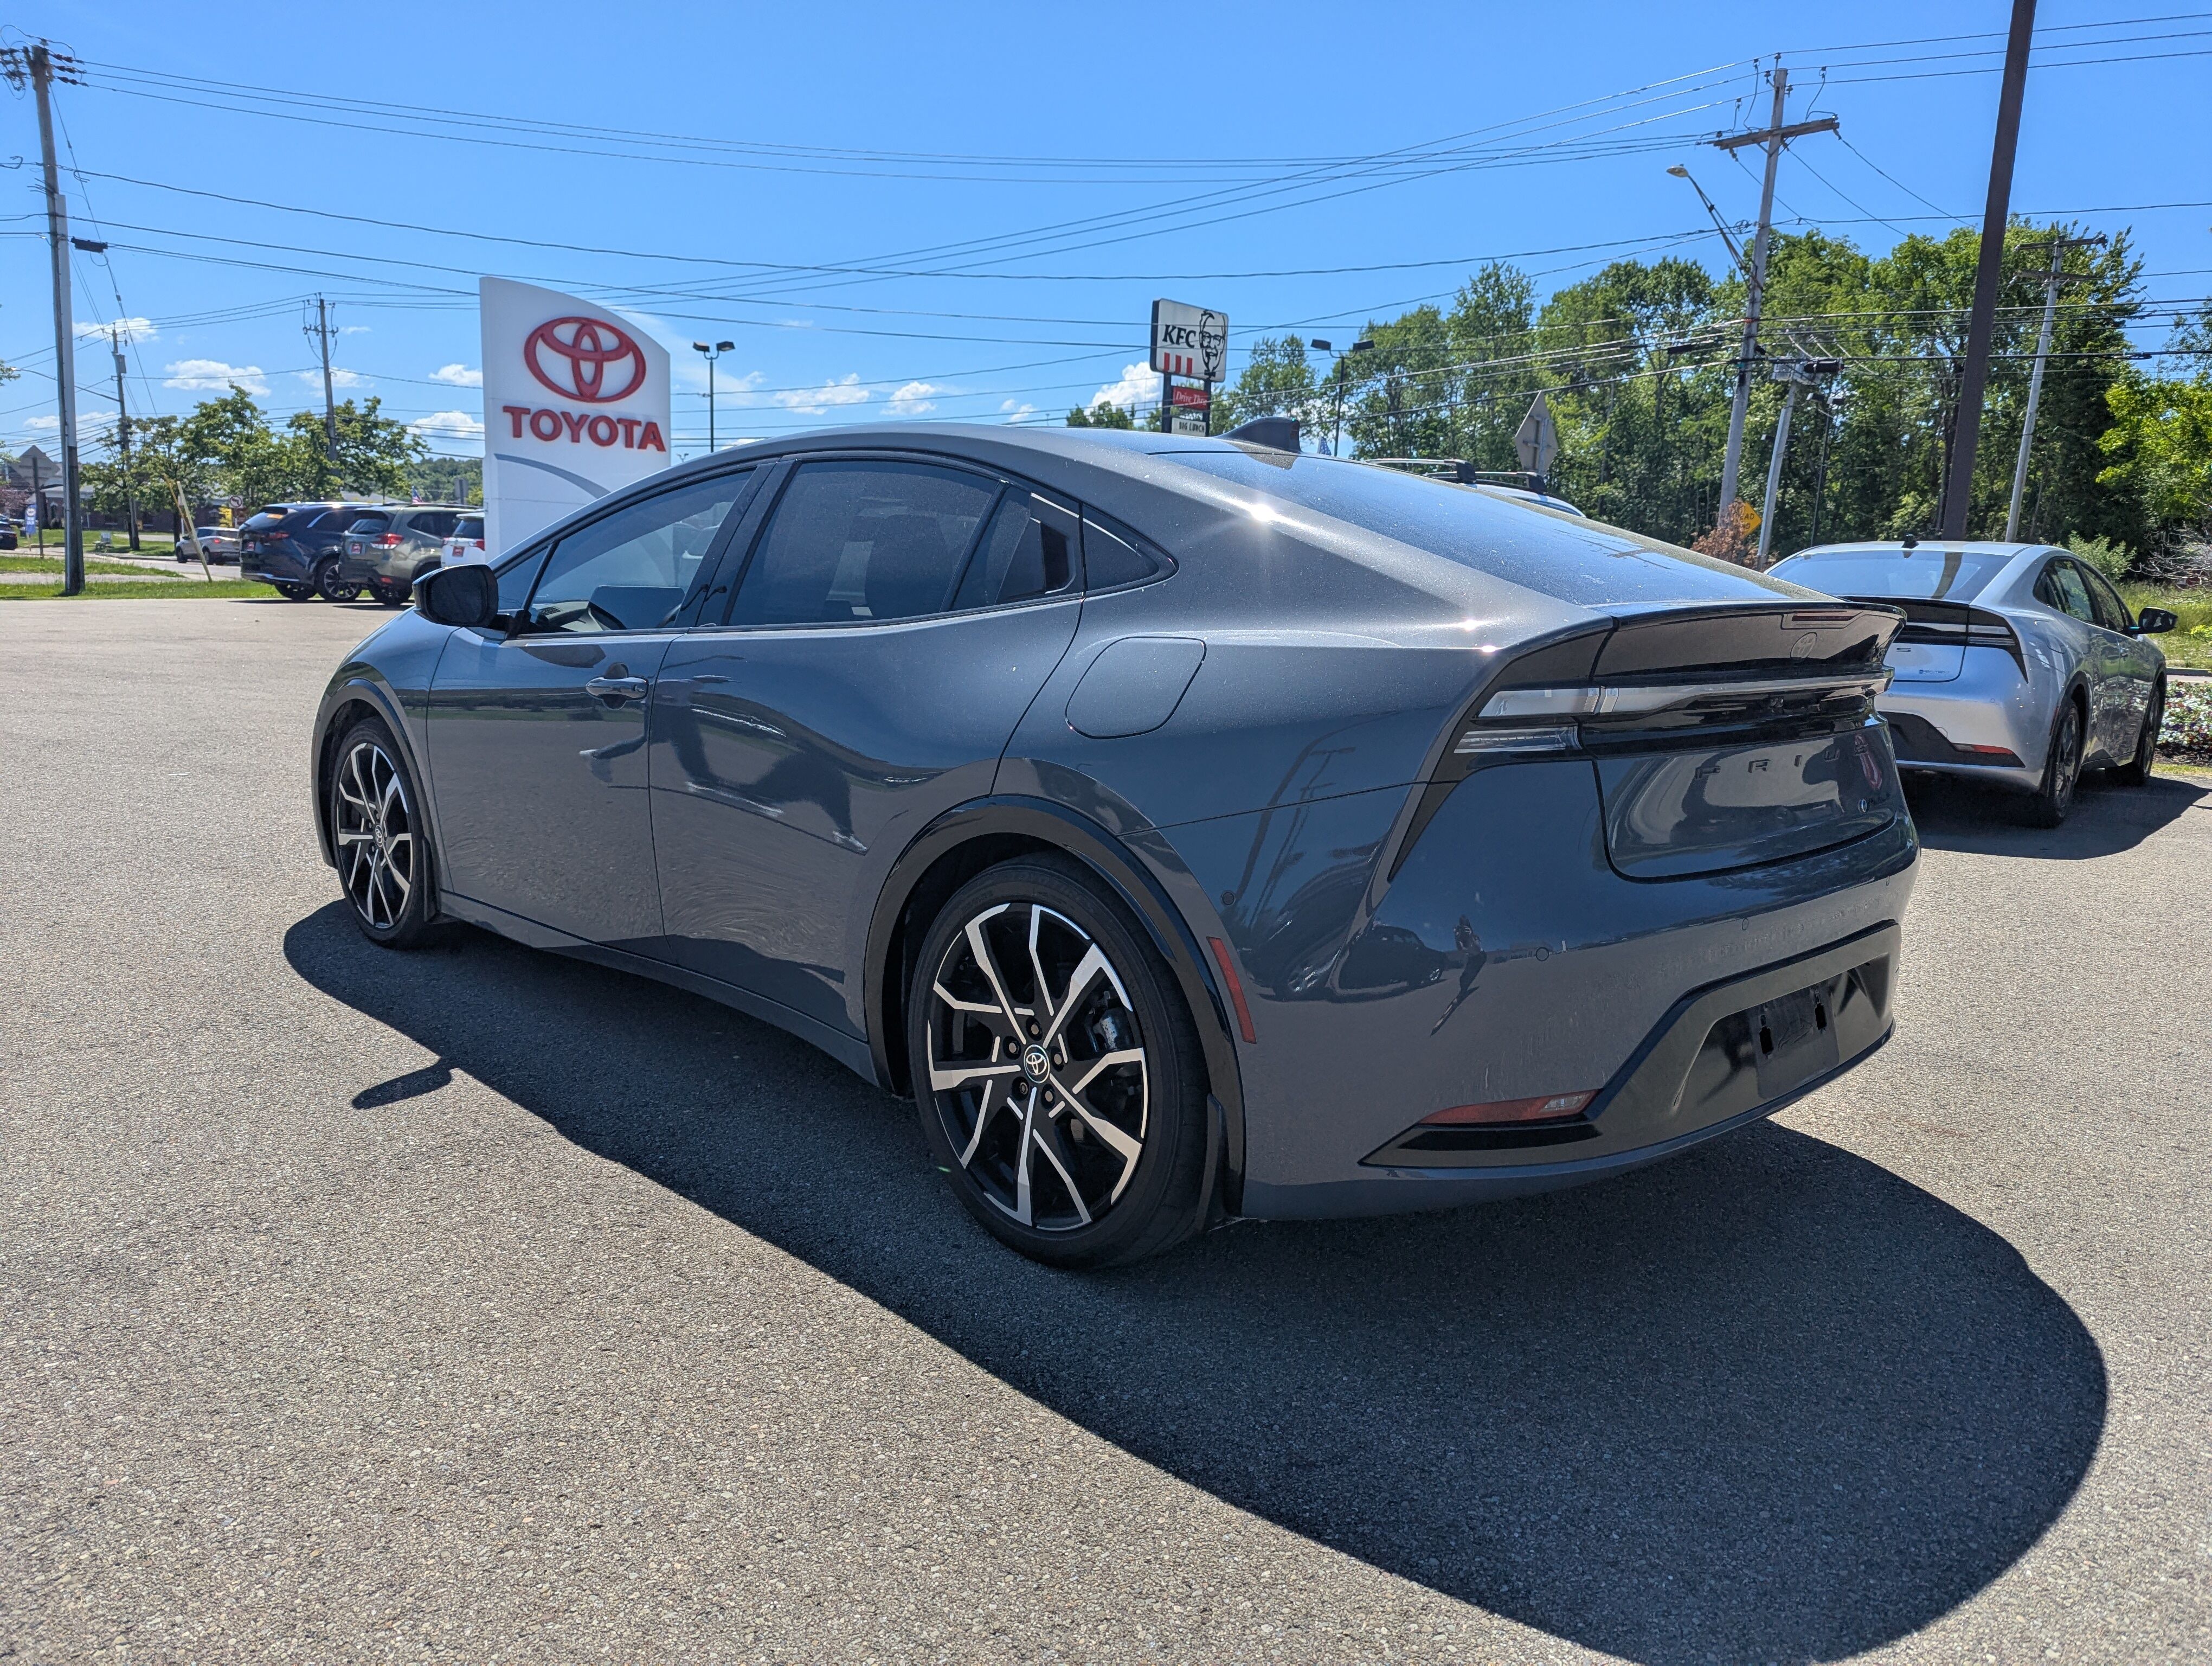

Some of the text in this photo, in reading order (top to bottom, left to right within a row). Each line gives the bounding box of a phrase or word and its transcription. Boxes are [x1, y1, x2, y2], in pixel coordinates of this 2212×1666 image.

[1162, 324, 1196, 349] KFC
[1175, 391, 1192, 403] Drive
[503, 405, 667, 452] TOYOTA
[1179, 422, 1205, 433] BIG LUNCH
[1694, 741, 1869, 780] PRIUS
